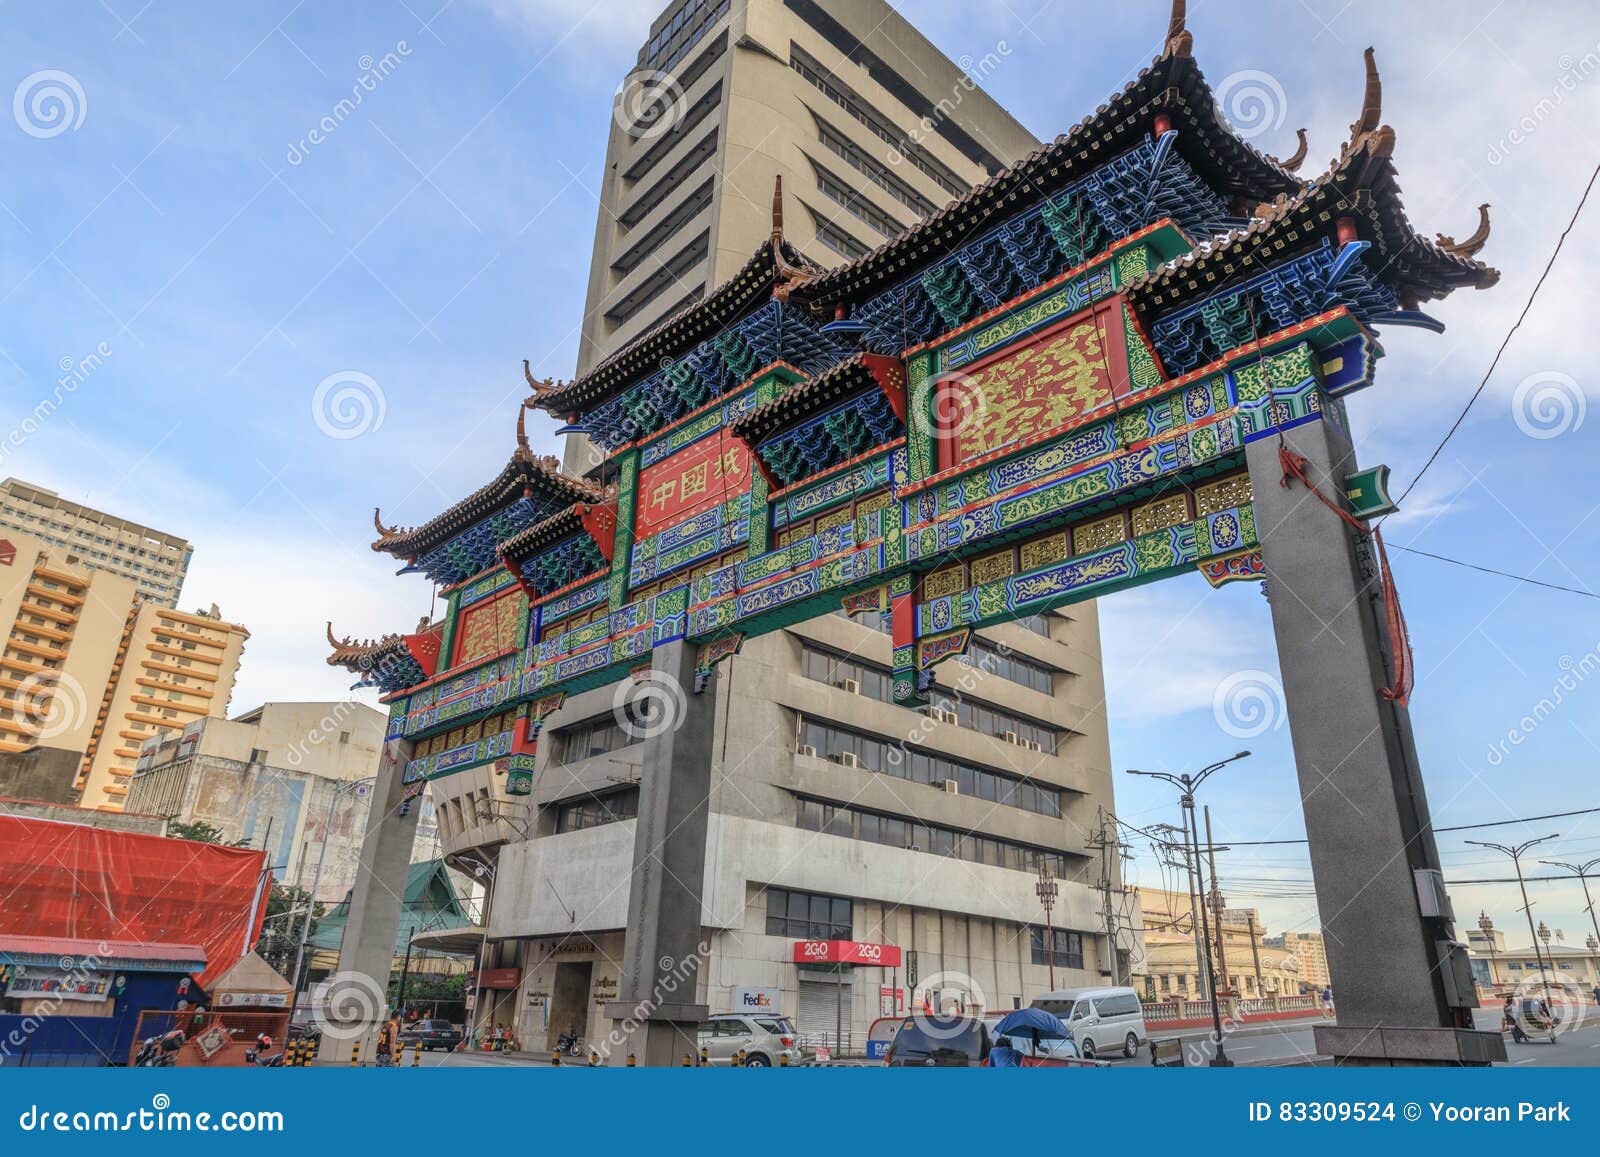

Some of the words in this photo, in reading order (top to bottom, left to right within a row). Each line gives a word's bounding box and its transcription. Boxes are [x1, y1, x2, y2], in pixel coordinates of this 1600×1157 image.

[804, 942, 829, 956] 2GO
[858, 944, 881, 959] 2GO
[743, 992, 771, 1007] FedEx
